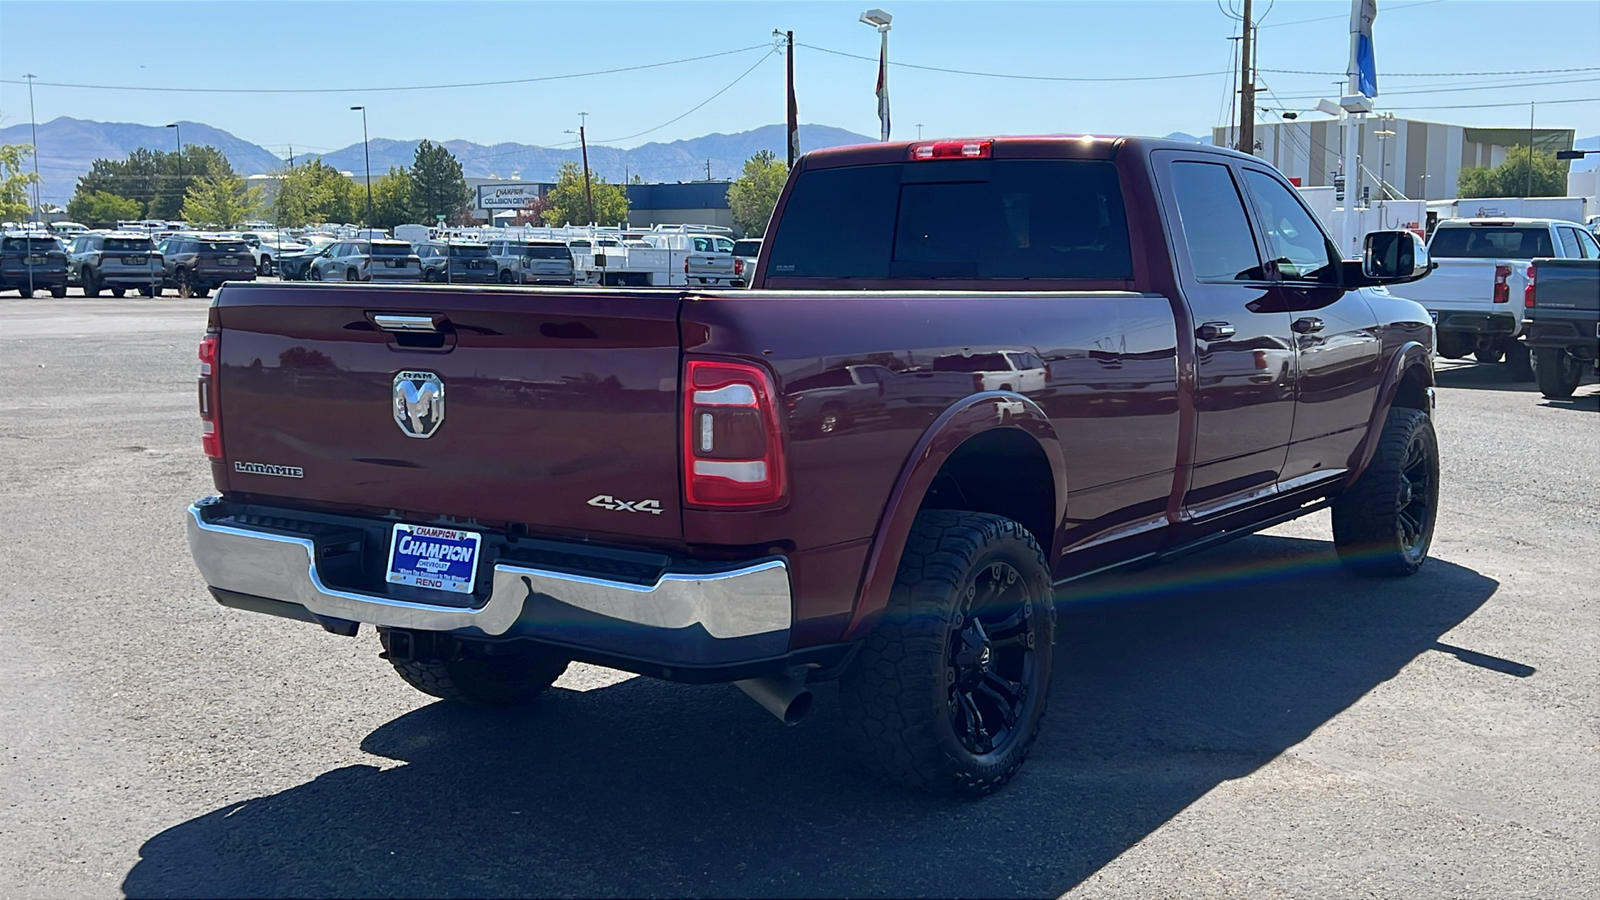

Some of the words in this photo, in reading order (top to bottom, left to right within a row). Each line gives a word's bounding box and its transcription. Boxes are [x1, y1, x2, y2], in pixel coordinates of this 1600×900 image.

[496, 188, 523, 197] CHAMPION
[235, 461, 303, 478] LARAMIE
[586, 494, 666, 514] 4x4
[416, 527, 457, 539] CHAMPION
[398, 535, 473, 562] CHAMPION
[419, 560, 448, 569] CHEVROLET
[415, 577, 442, 588] RENO
